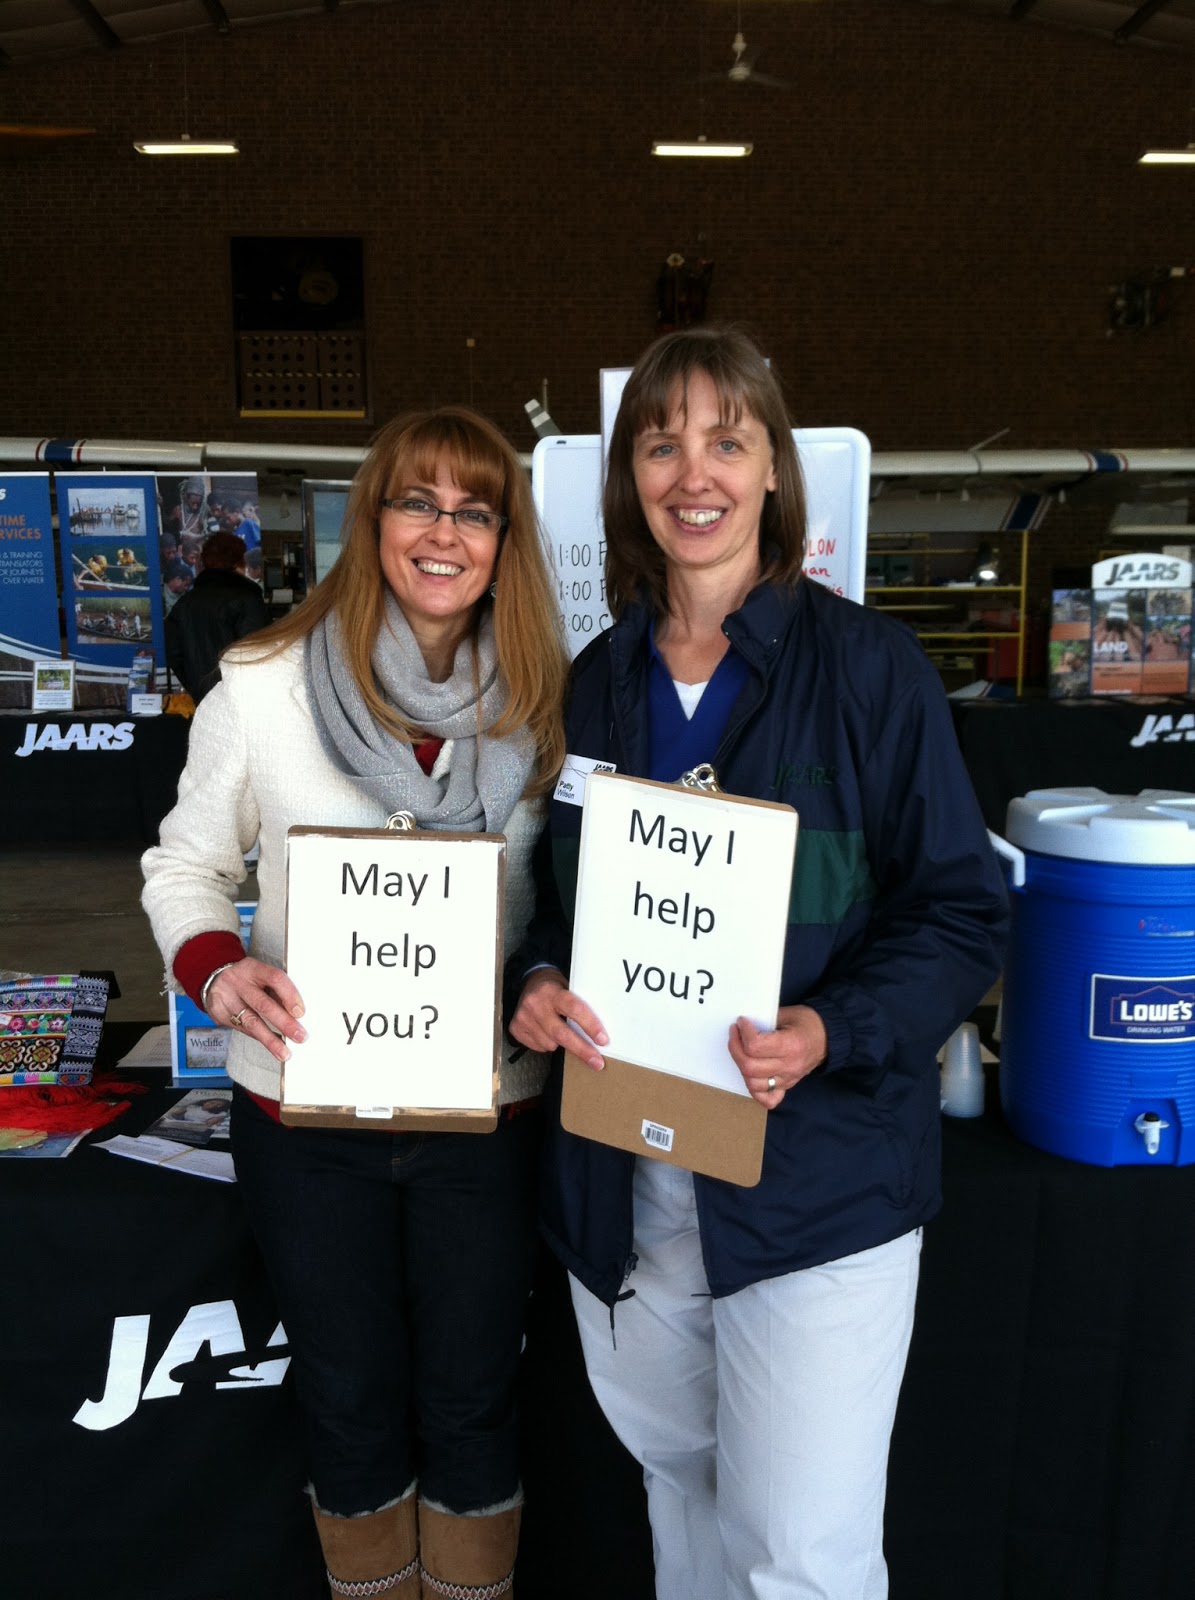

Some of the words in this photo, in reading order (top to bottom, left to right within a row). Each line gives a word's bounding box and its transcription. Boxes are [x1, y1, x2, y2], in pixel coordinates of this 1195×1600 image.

[10, 551, 43, 560] TRAINING
[3, 577, 21, 585] OVER
[22, 576, 45, 585] WATER
[1105, 563, 1180, 586] JAARS
[14, 721, 137, 758] JAARS
[629, 808, 713, 867] May
[726, 830, 735, 865] I
[341, 862, 429, 906] May
[443, 865, 450, 899] I
[633, 880, 716, 940] help
[351, 931, 437, 977] help
[622, 958, 714, 1005] you?
[341, 1004, 440, 1045] you?
[1120, 999, 1193, 1022] LOWE'S
[190, 1037, 224, 1049] Wycliffe
[1126, 1026, 1162, 1034] DRINKING
[1163, 1025, 1187, 1034] WATER
